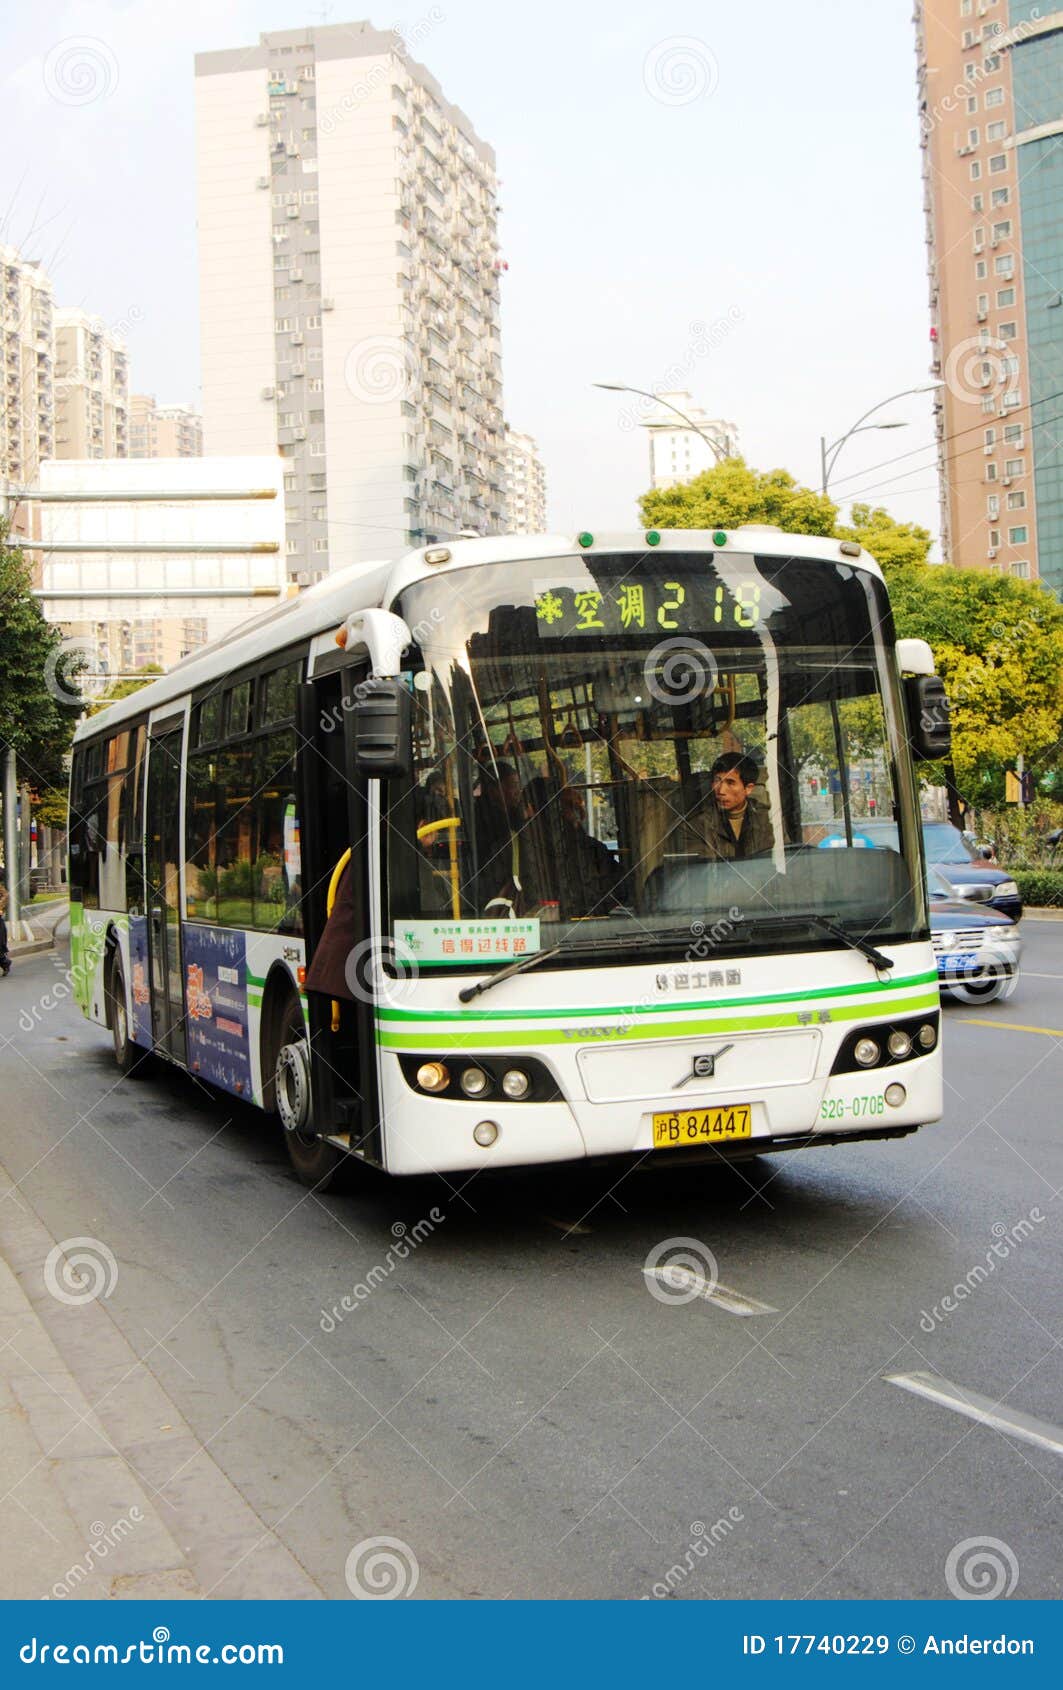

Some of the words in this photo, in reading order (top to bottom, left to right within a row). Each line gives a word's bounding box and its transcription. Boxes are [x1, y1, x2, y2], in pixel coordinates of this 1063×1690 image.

[574, 583, 645, 630] 空调
[657, 581, 761, 630] 218
[441, 937, 527, 954] 信得过线路
[674, 969, 742, 990] 巴士集团
[561, 1025, 628, 1039] VOLVO
[821, 1095, 884, 1119] S2G-070B
